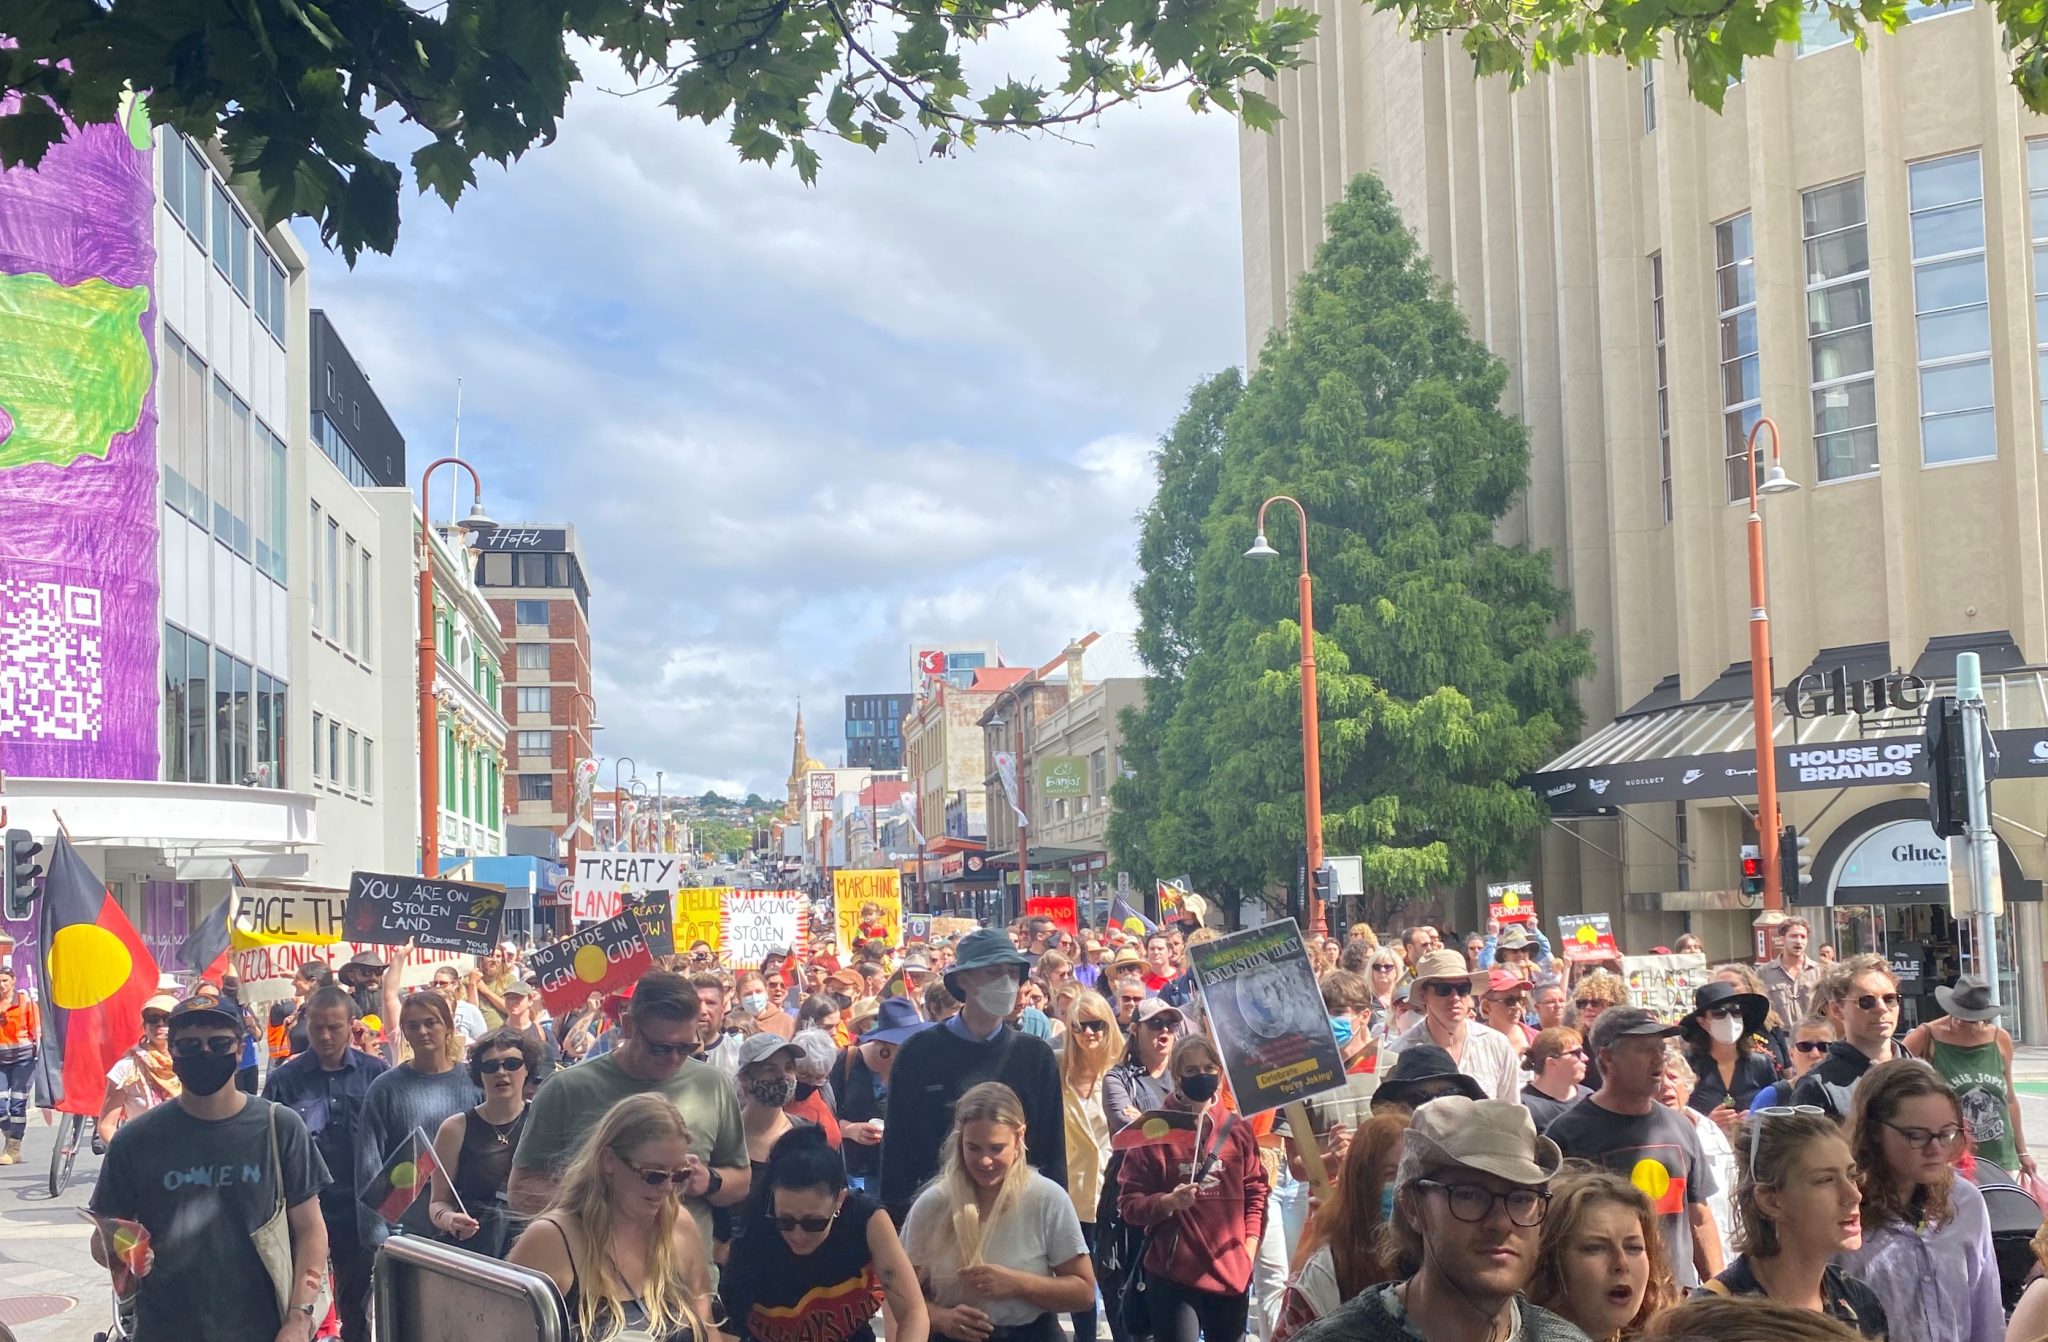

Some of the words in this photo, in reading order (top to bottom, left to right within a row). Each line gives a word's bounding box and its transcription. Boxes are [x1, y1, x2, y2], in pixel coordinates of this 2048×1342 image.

[488, 529, 541, 549] Hotel
[1785, 665, 1927, 719] Glue
[1789, 746, 1879, 768] HOUSE
[1884, 743, 1922, 760] OF
[1800, 760, 1913, 782] BRANDS
[812, 780, 834, 790] MUSIC
[1625, 776, 1665, 786] NUDELUCY
[812, 789, 834, 797] CENTRE
[1891, 843, 1947, 862] Glue.
[580, 858, 674, 884] TREATY
[358, 877, 399, 899] YOU
[409, 884, 442, 902] ARE
[447, 889, 469, 902] ON
[836, 875, 899, 898] MARCHING
[1488, 886, 1503, 898] NO
[1508, 884, 1533, 895] PRIDE
[392, 901, 450, 916] STOLEN
[573, 890, 622, 918] LAND
[730, 900, 796, 915] WALKING
[1033, 907, 1072, 920] LAND
[1492, 904, 1534, 918] GENOCIDE
[234, 896, 298, 936] FACE
[382, 915, 431, 931] LAND
[754, 915, 771, 926] ON
[466, 939, 488, 948] YOUR
[535, 950, 554, 967] NO
[561, 927, 606, 956] PRIDE
[612, 917, 628, 933] IN
[733, 926, 784, 942] STOLEN
[466, 946, 493, 958] MIND!
[1203, 949, 1270, 986] INVASION
[1270, 937, 1300, 959] DAY
[1629, 967, 1698, 989] CHANGE
[1629, 989, 1659, 1008] THE
[1261, 1067, 1299, 1085] Celebrate
[1280, 1080, 1304, 1094] You're
[1305, 1069, 1334, 1086] Joking!
